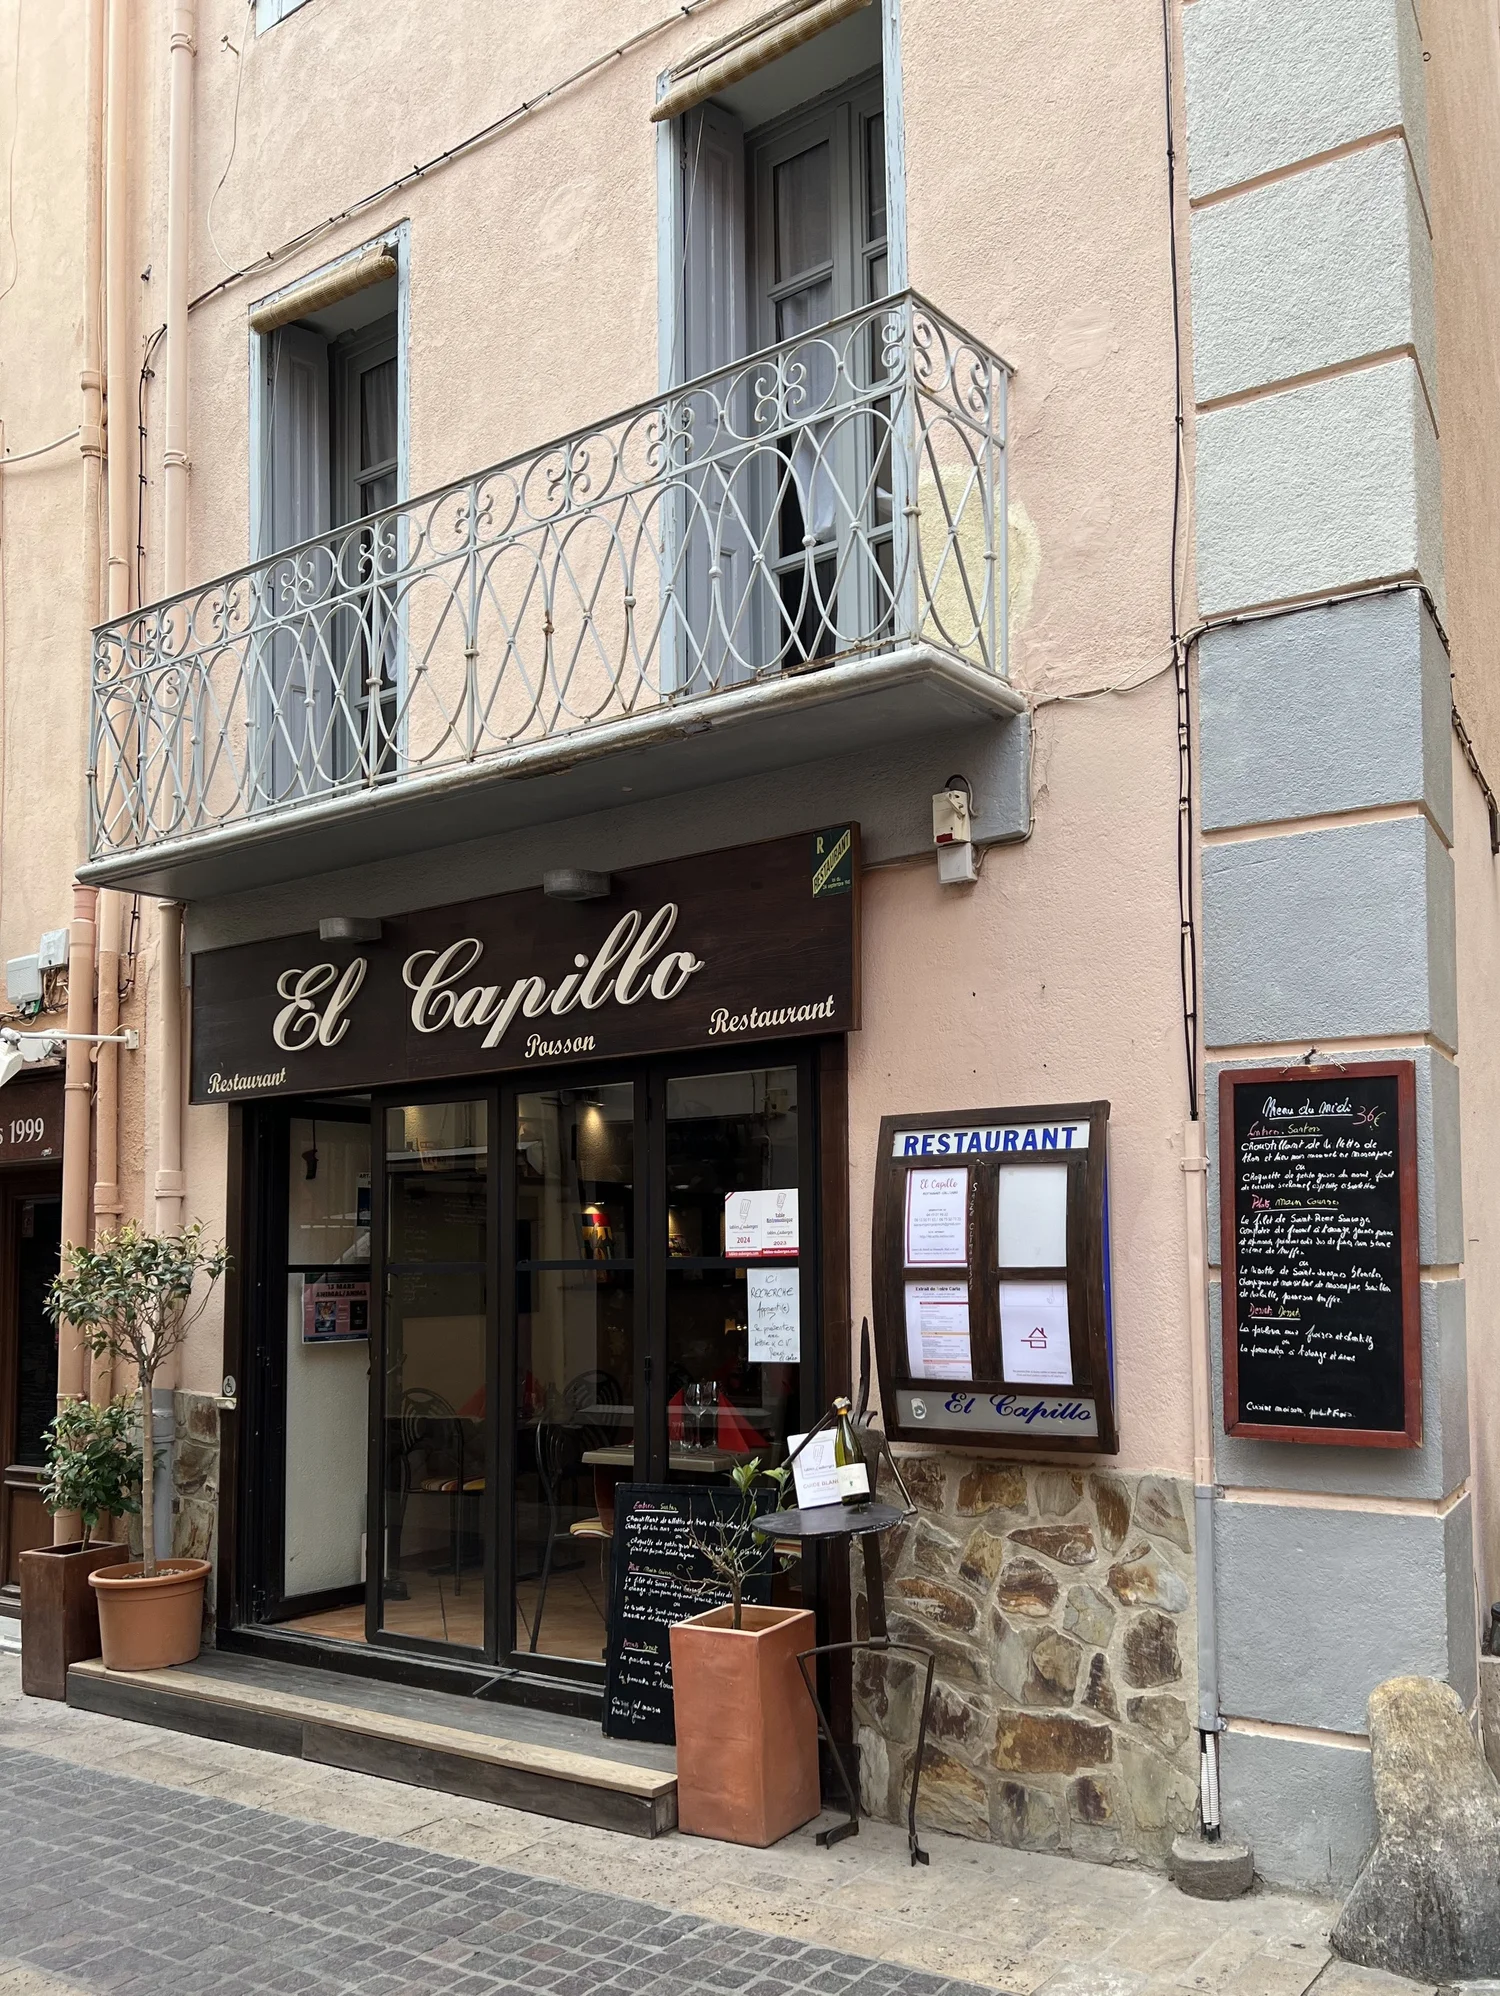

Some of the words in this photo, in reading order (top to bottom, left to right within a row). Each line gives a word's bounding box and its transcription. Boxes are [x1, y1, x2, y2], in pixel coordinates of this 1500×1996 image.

[817, 837, 824, 854] R
[814, 832, 850, 893] RESTAURANT
[273, 957, 367, 1050] El
[402, 902, 705, 1048] Capillo
[708, 994, 835, 1035] Restaurant
[524, 1033, 596, 1058] Poisson
[207, 1067, 286, 1094] Restaurant
[1262, 1096, 1295, 1117] Menu
[1298, 1098, 1315, 1114] du
[9, 1117, 44, 1144] 1999
[904, 1126, 1078, 1156] RESTAURANT
[1305, 1138, 1320, 1149] de
[1364, 1139, 1378, 1149] de
[1264, 1153, 1273, 1162] et
[1284, 1170, 1294, 1179] de
[920, 1178, 930, 1190] El
[931, 1177, 958, 1194] Capillo
[1240, 1214, 1249, 1225] Le
[1275, 1214, 1286, 1223] de
[1274, 1226, 1285, 1234] de
[1265, 1246, 1275, 1255] de
[1280, 1266, 1289, 1276] de
[751, 1287, 794, 1298] RECHERCHE
[1239, 1289, 1249, 1298] de
[1240, 1323, 1249, 1333] La
[945, 1392, 976, 1414] El
[990, 1393, 1091, 1423] Capillo
